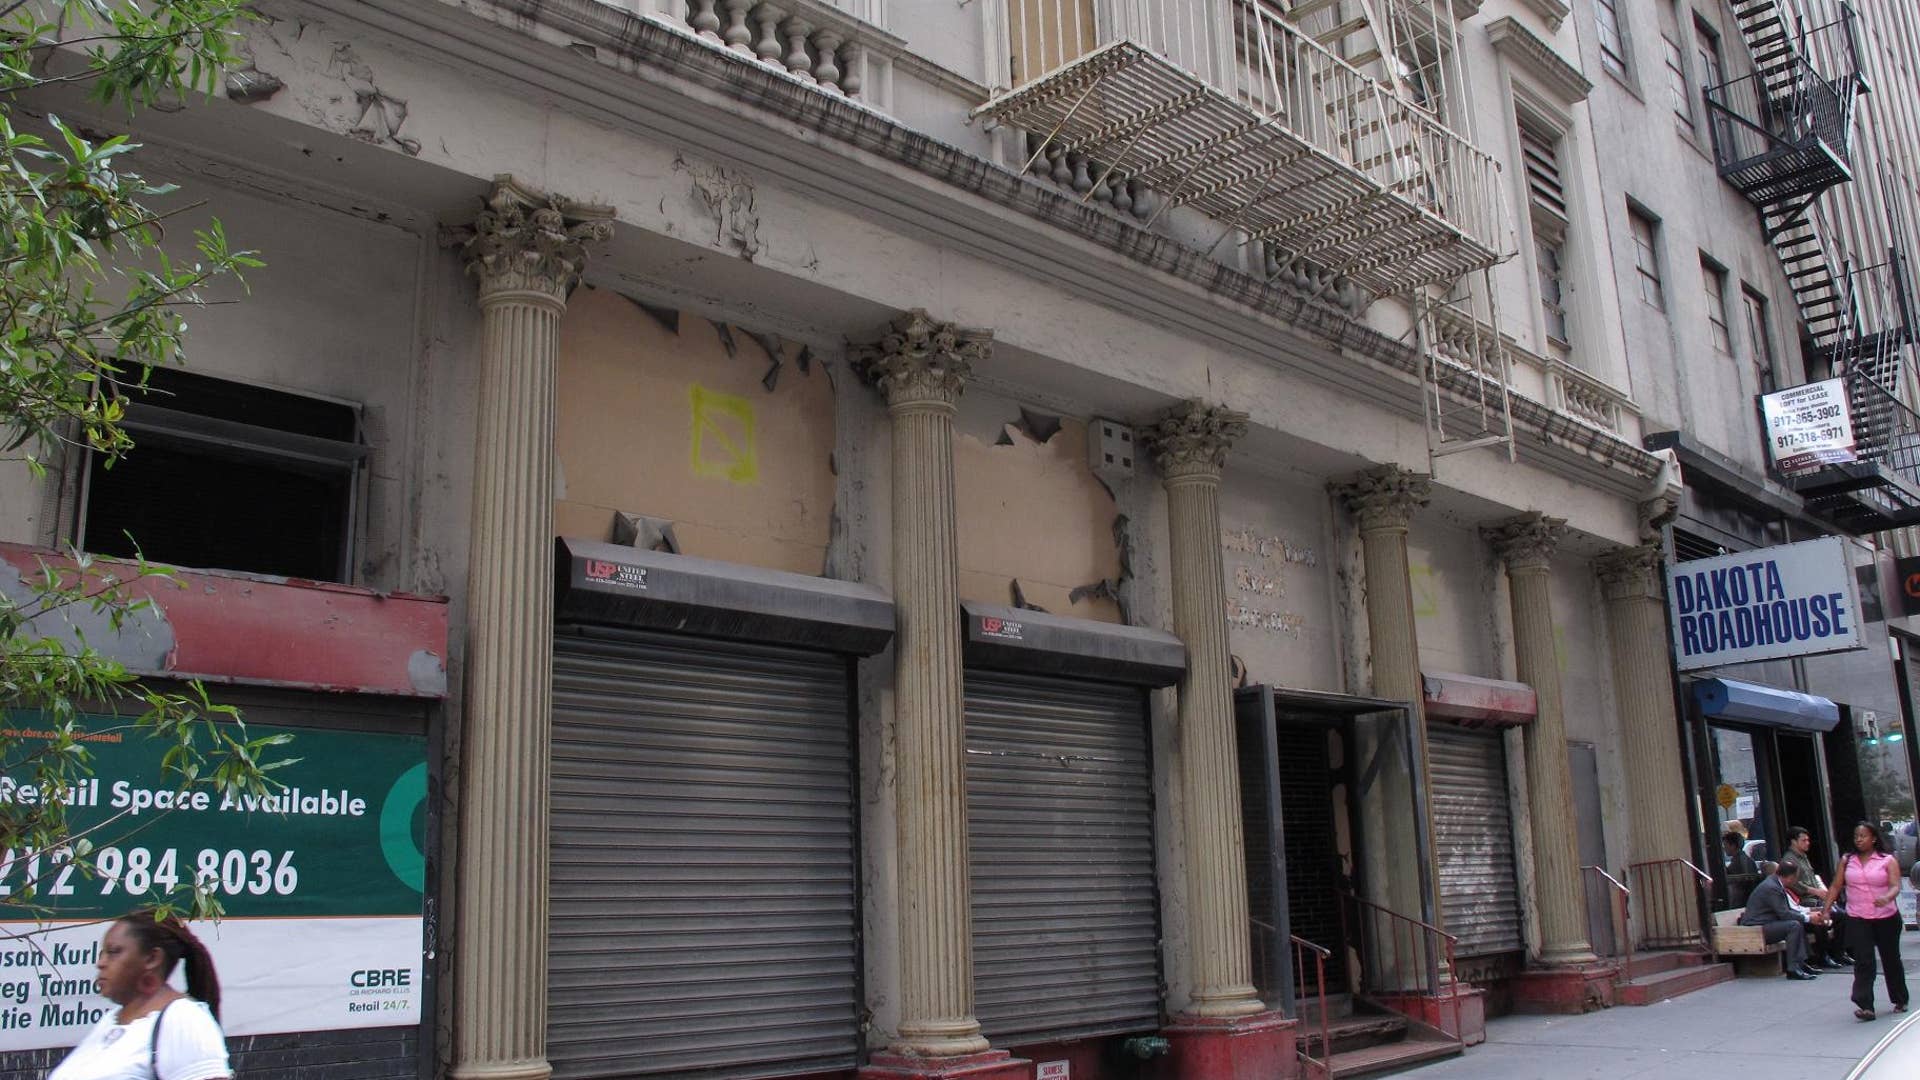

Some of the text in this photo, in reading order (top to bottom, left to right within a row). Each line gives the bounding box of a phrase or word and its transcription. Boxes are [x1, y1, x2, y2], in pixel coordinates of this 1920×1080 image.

[1781, 385, 1825, 401] COMMERCIAL
[1808, 391, 1829, 401] LEASE
[586, 559, 617, 579] USP
[1674, 560, 1785, 615] DAKOTA
[982, 616, 1002, 633] USP
[1680, 592, 1848, 657] ROADHOUSE
[110, 780, 210, 815] Space
[219, 787, 366, 816] Available
[96, 846, 179, 896] 984
[197, 848, 298, 895] 8036
[53, 941, 104, 966] Kurl
[350, 968, 411, 987] CBRE
[0, 981, 30, 1004] eg
[40, 1001, 109, 1027] Maho
[349, 1000, 380, 1012] Retail
